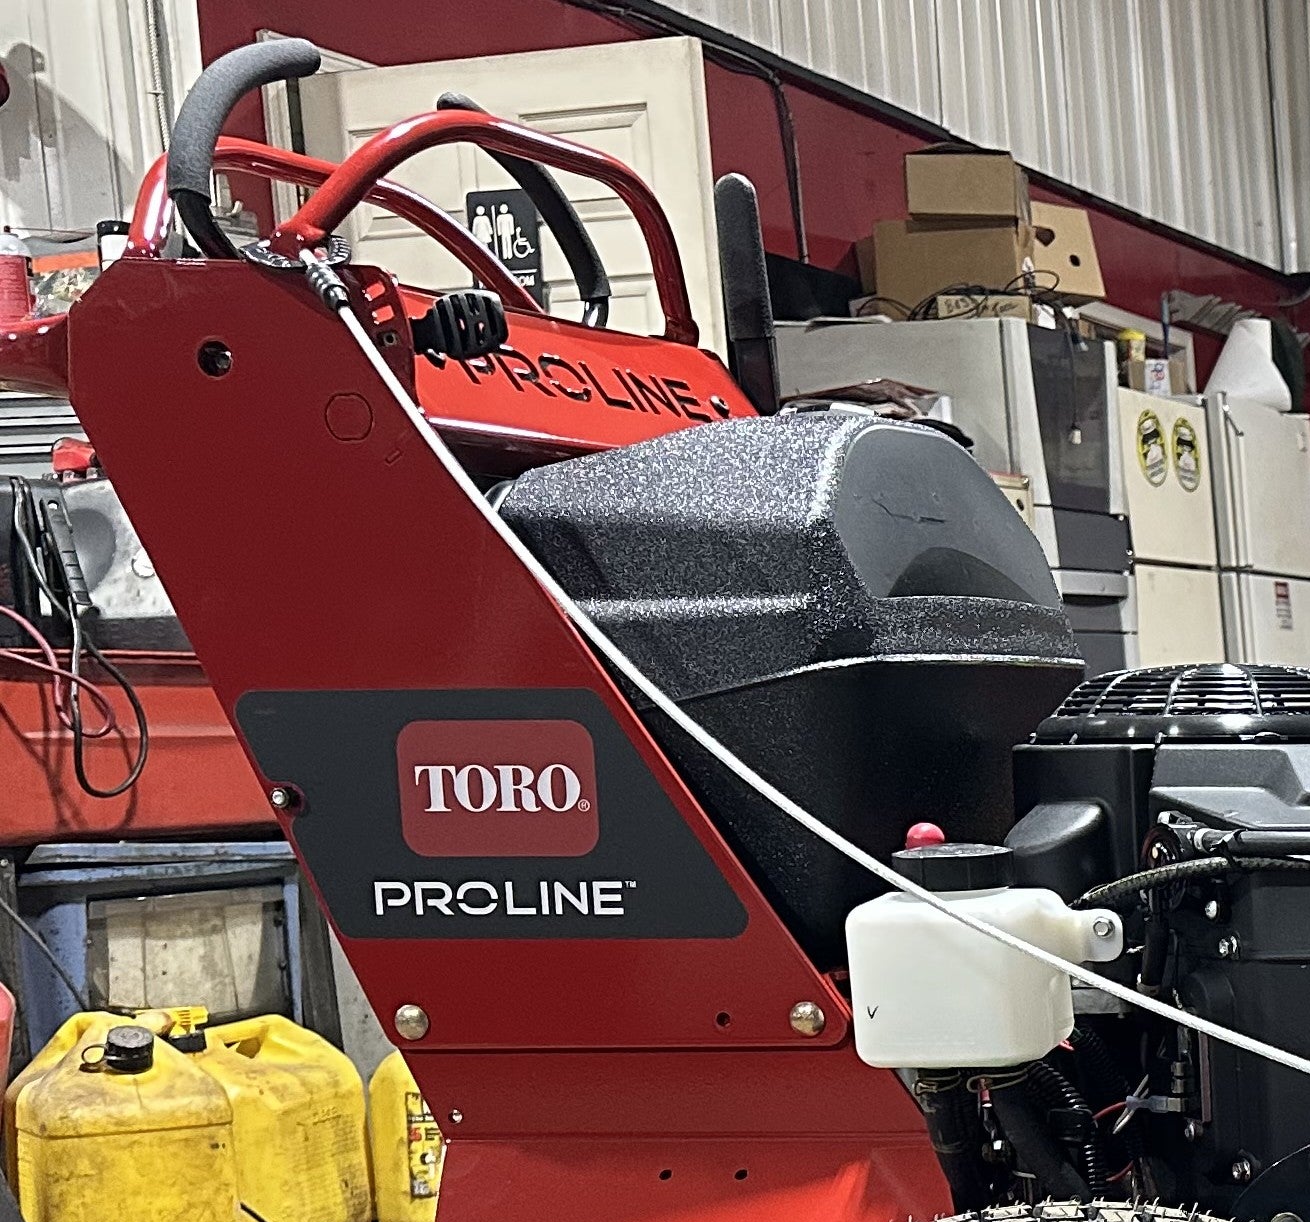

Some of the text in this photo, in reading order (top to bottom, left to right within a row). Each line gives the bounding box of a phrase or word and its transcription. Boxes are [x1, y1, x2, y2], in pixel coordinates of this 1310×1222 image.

[460, 345, 713, 423] PROLINE
[413, 763, 582, 813] TORO
[374, 881, 625, 916] PROLINE
